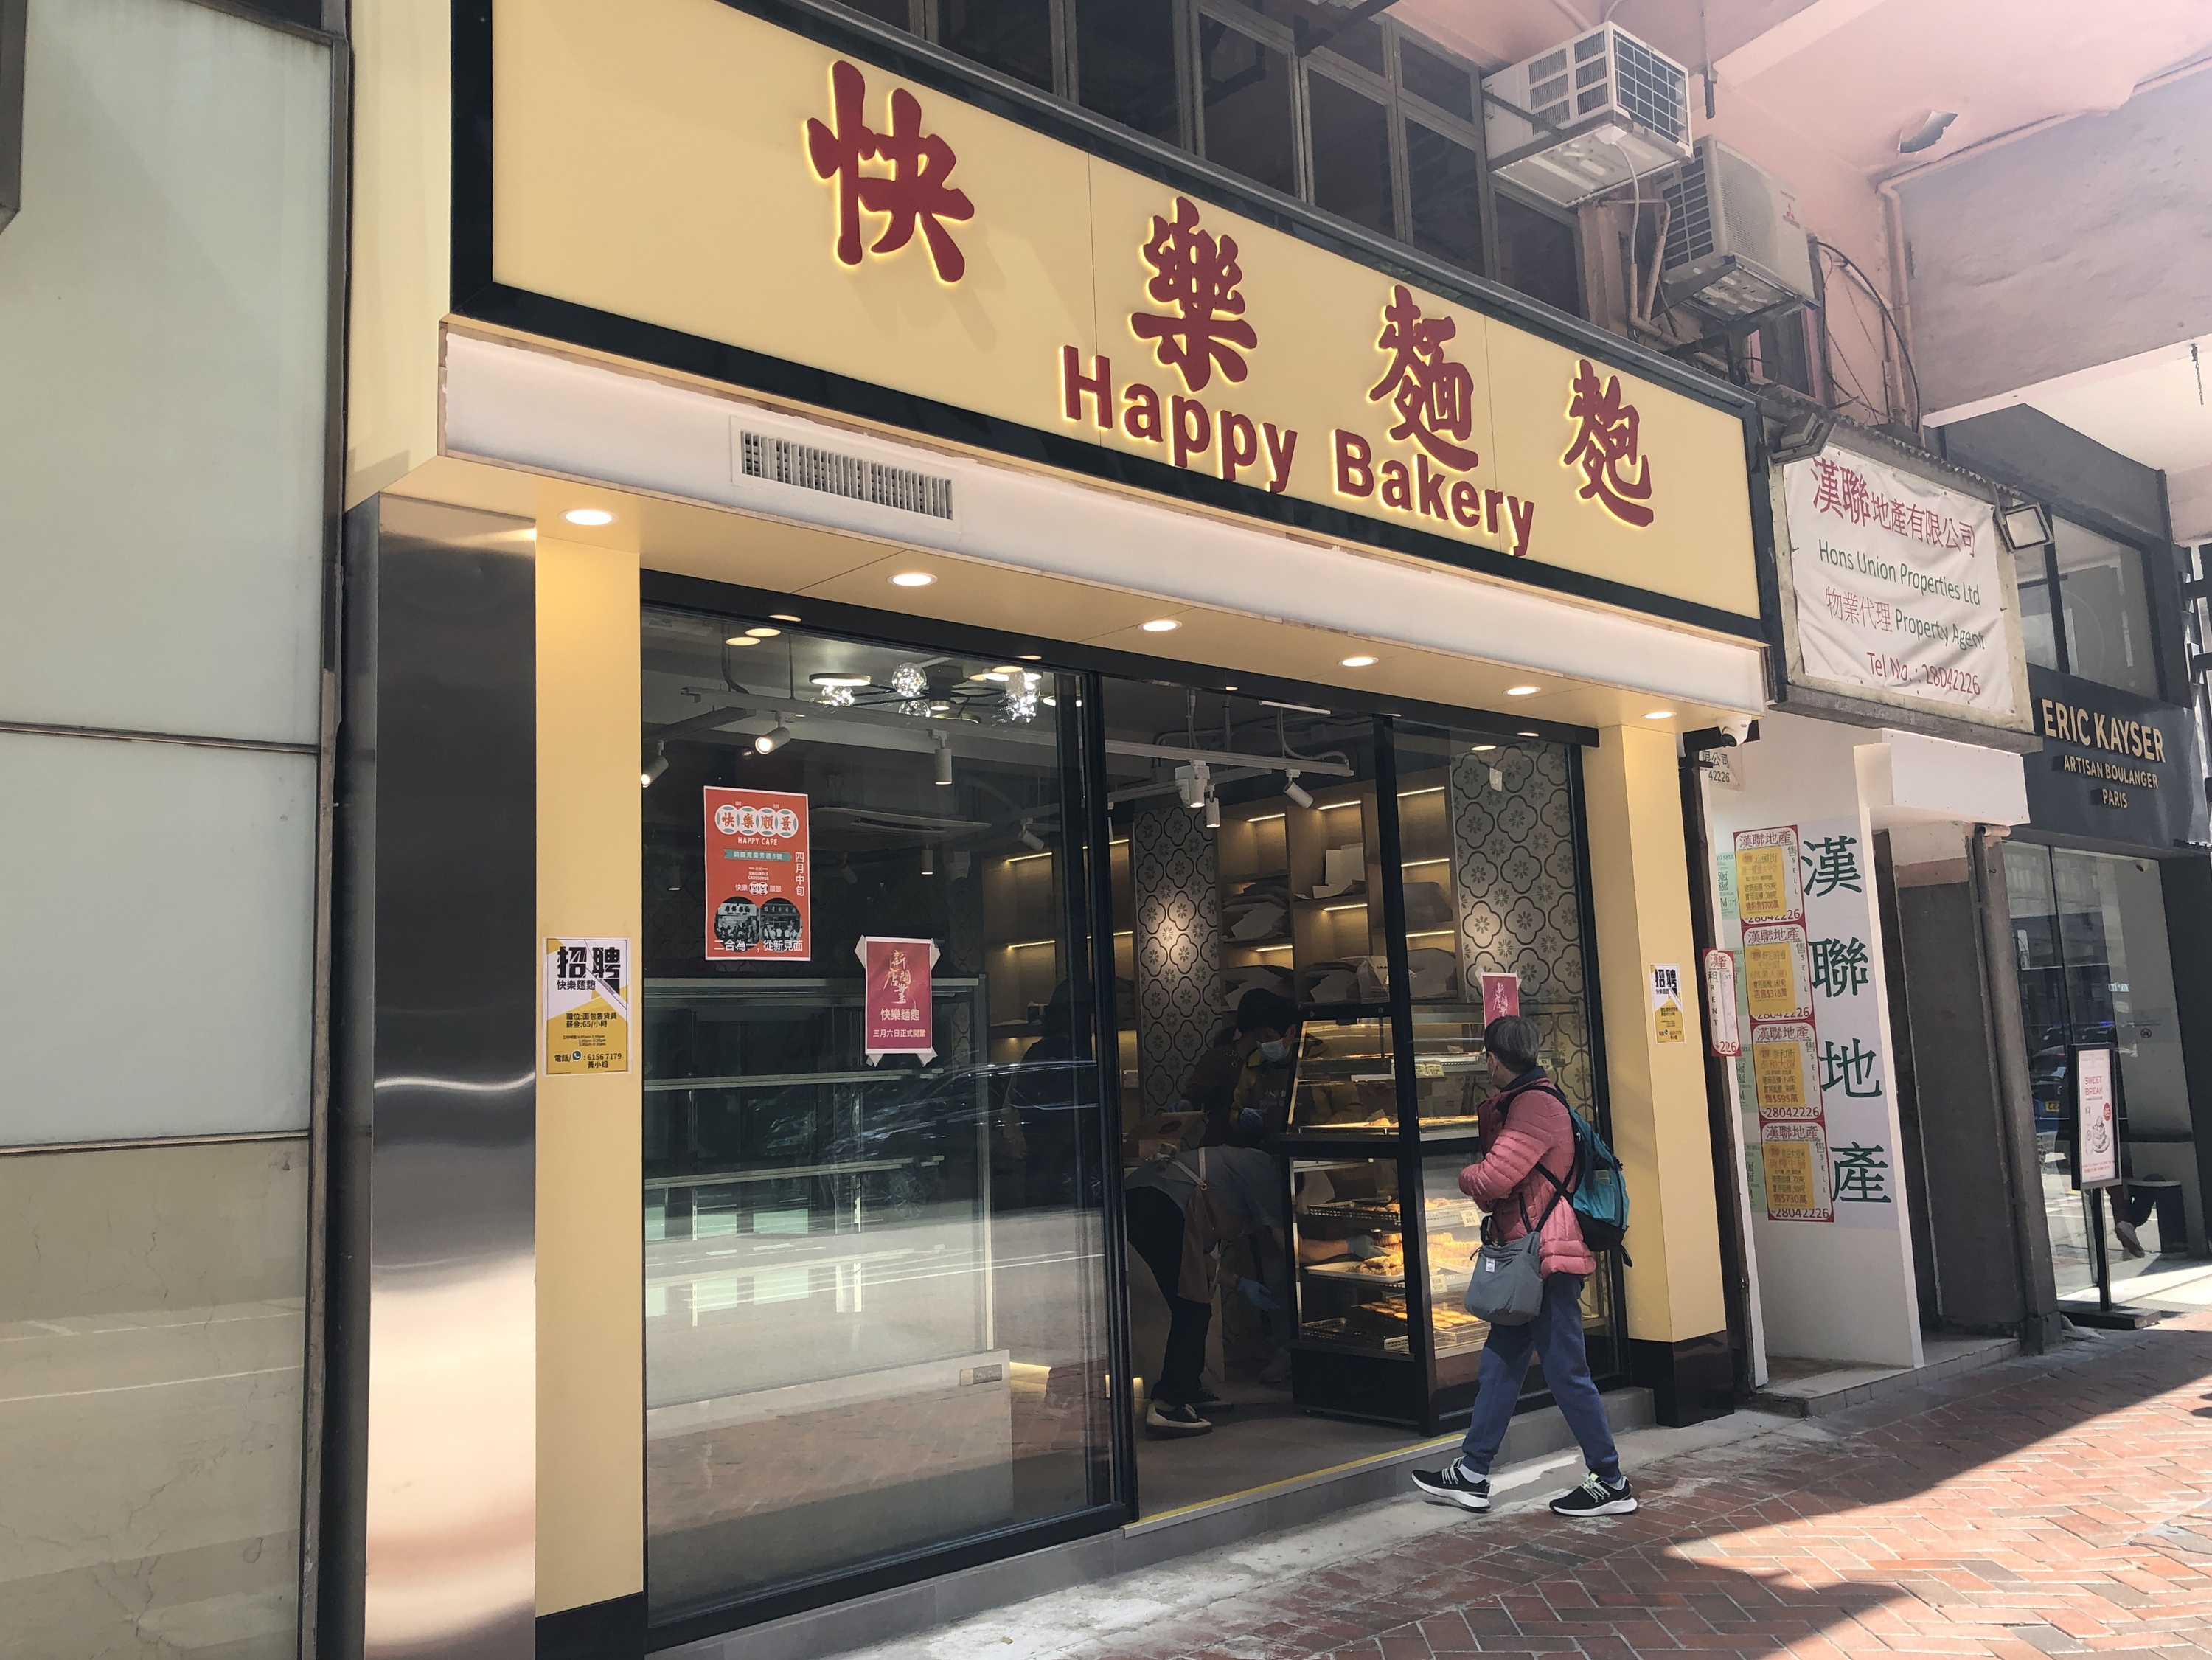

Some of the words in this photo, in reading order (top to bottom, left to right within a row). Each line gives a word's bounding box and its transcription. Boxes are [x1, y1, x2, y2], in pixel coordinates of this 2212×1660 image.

[1062, 344, 1298, 493] Happy
[1332, 429, 1534, 557] Bakery
[1811, 456, 1976, 558] 漢聯地產有限公司
[1819, 538, 1854, 570] Hons
[1857, 551, 1896, 583] Union
[1900, 563, 1961, 601] Properties
[1963, 582, 1980, 605] Ltd
[1825, 586, 1893, 633] 物業代理
[1896, 608, 1949, 647] Property
[1952, 624, 1986, 651] Agent
[1867, 652, 1887, 678] Tel
[1921, 664, 1980, 695] 28042226
[2042, 698, 2091, 746] ERIC
[2094, 712, 2166, 763] KAYSER
[2065, 755, 2103, 779] ARTISAN
[2105, 763, 2159, 789] BOULANGER
[2102, 788, 2128, 808] PARIS
[737, 836, 759, 844] HAPPY
[761, 838, 778, 846] CAFE
[1739, 830, 1792, 848] 漢聯地產
[795, 852, 805, 897] 四月中旬
[1747, 927, 1800, 944] 漢聯地產
[557, 946, 621, 979] 招聘
[1655, 969, 1677, 987] 招聘
[1707, 970, 1718, 983] 租
[1801, 835, 1891, 1203] 漢聯地產
[1756, 1025, 1809, 1041] 漢聯地產
[2085, 1076, 2102, 1085] SWEET
[2085, 1087, 2103, 1095] BREAK
[1766, 1107, 1819, 1118] 28042226
[1766, 1125, 1819, 1139] 漢聯地產
[1775, 1208, 1829, 1218] 28042226
